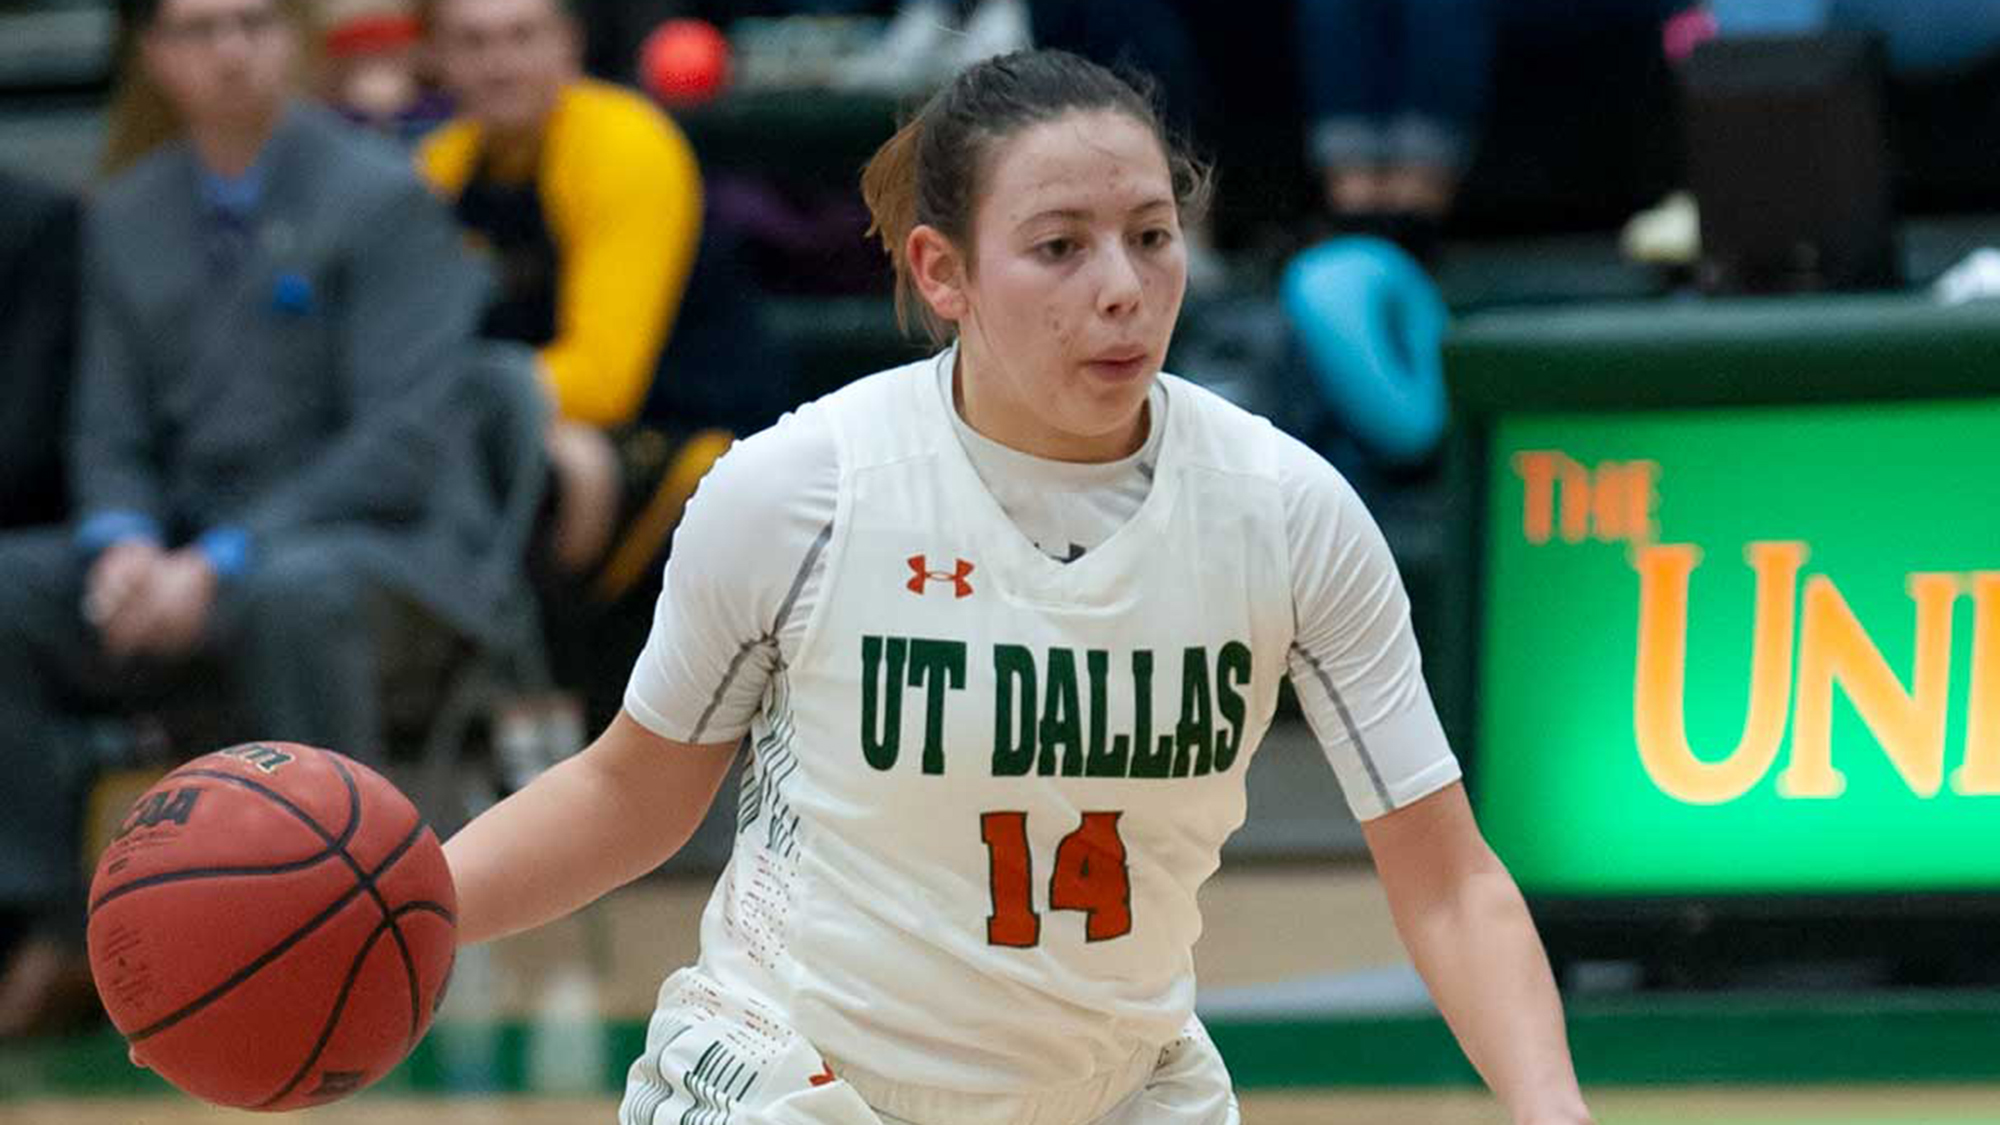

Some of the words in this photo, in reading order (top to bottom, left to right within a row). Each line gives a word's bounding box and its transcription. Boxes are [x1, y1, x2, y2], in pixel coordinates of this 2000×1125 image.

[1513, 450, 1660, 543] THE
[861, 635, 966, 775] UT
[993, 640, 1252, 778] DALLAS
[980, 811, 1132, 948] 14
